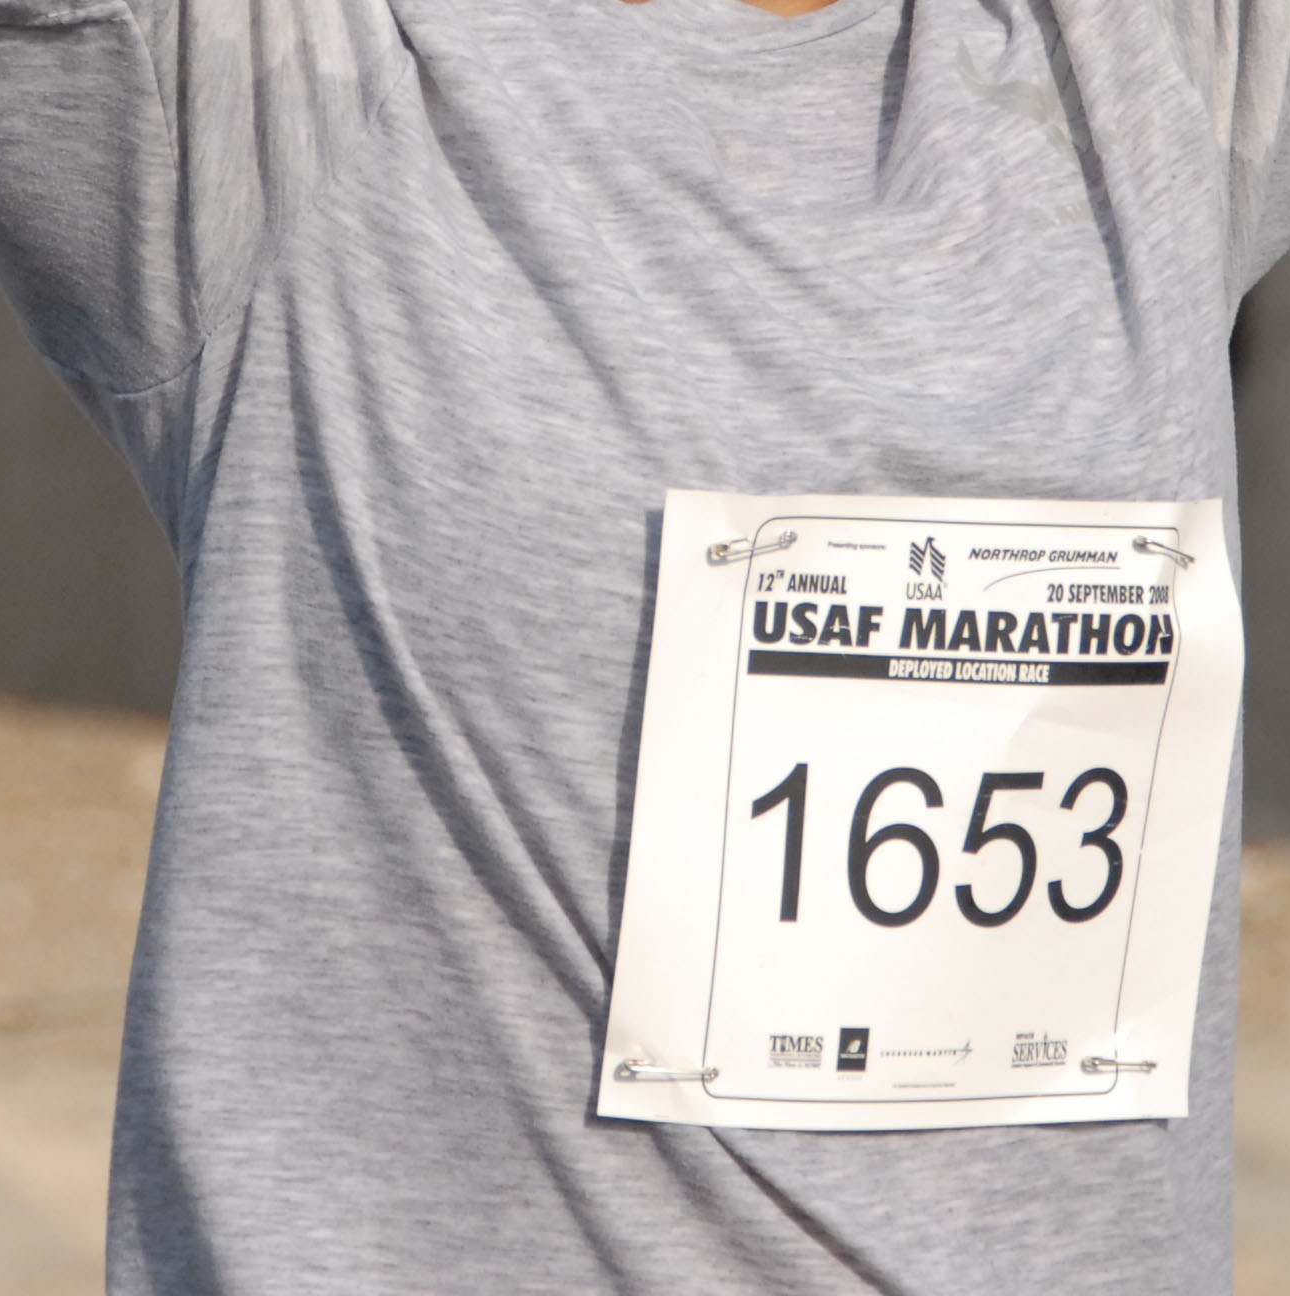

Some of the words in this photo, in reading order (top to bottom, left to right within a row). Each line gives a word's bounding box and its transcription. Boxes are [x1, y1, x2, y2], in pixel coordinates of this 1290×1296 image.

[968, 547, 1046, 562] NORTHROP
[1048, 549, 1118, 564] GRUMMAN
[787, 573, 848, 595] ANNUAL
[1046, 583, 1064, 603] 20
[1067, 583, 1144, 605] SEPTEMBER
[752, 600, 884, 648] USAF
[898, 607, 1174, 655] MARATHON
[888, 658, 953, 680] DEPLOYED
[955, 660, 1017, 683] LOCATION
[1018, 663, 1051, 684] RACE
[750, 762, 1129, 929] 1653
[769, 1035, 824, 1053] TIMES
[1011, 1039, 1068, 1062] SERVICES
